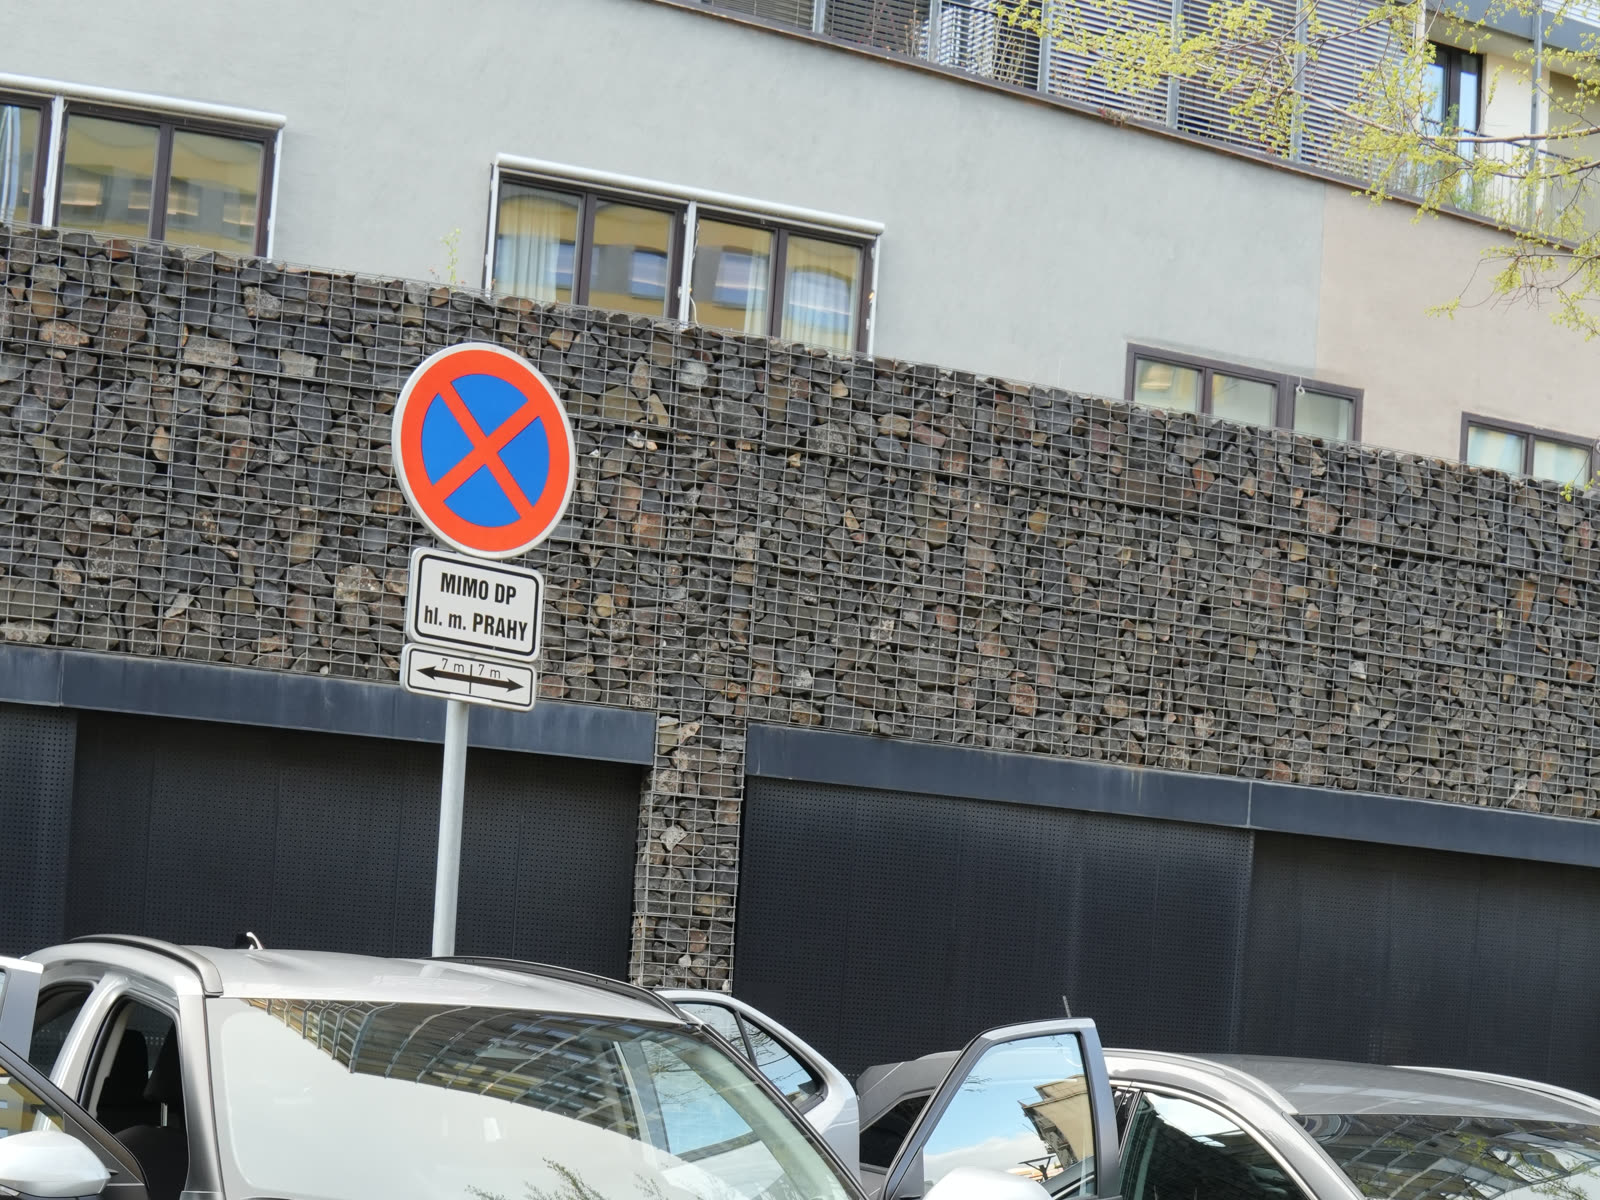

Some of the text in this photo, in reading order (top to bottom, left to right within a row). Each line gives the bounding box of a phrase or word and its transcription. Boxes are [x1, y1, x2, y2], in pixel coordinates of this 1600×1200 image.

[440, 572, 517, 605] MIMO DP
[424, 605, 528, 641] hl. m. PRAHY
[441, 658, 465, 673] 7 m
[478, 664, 501, 678] 7 m
